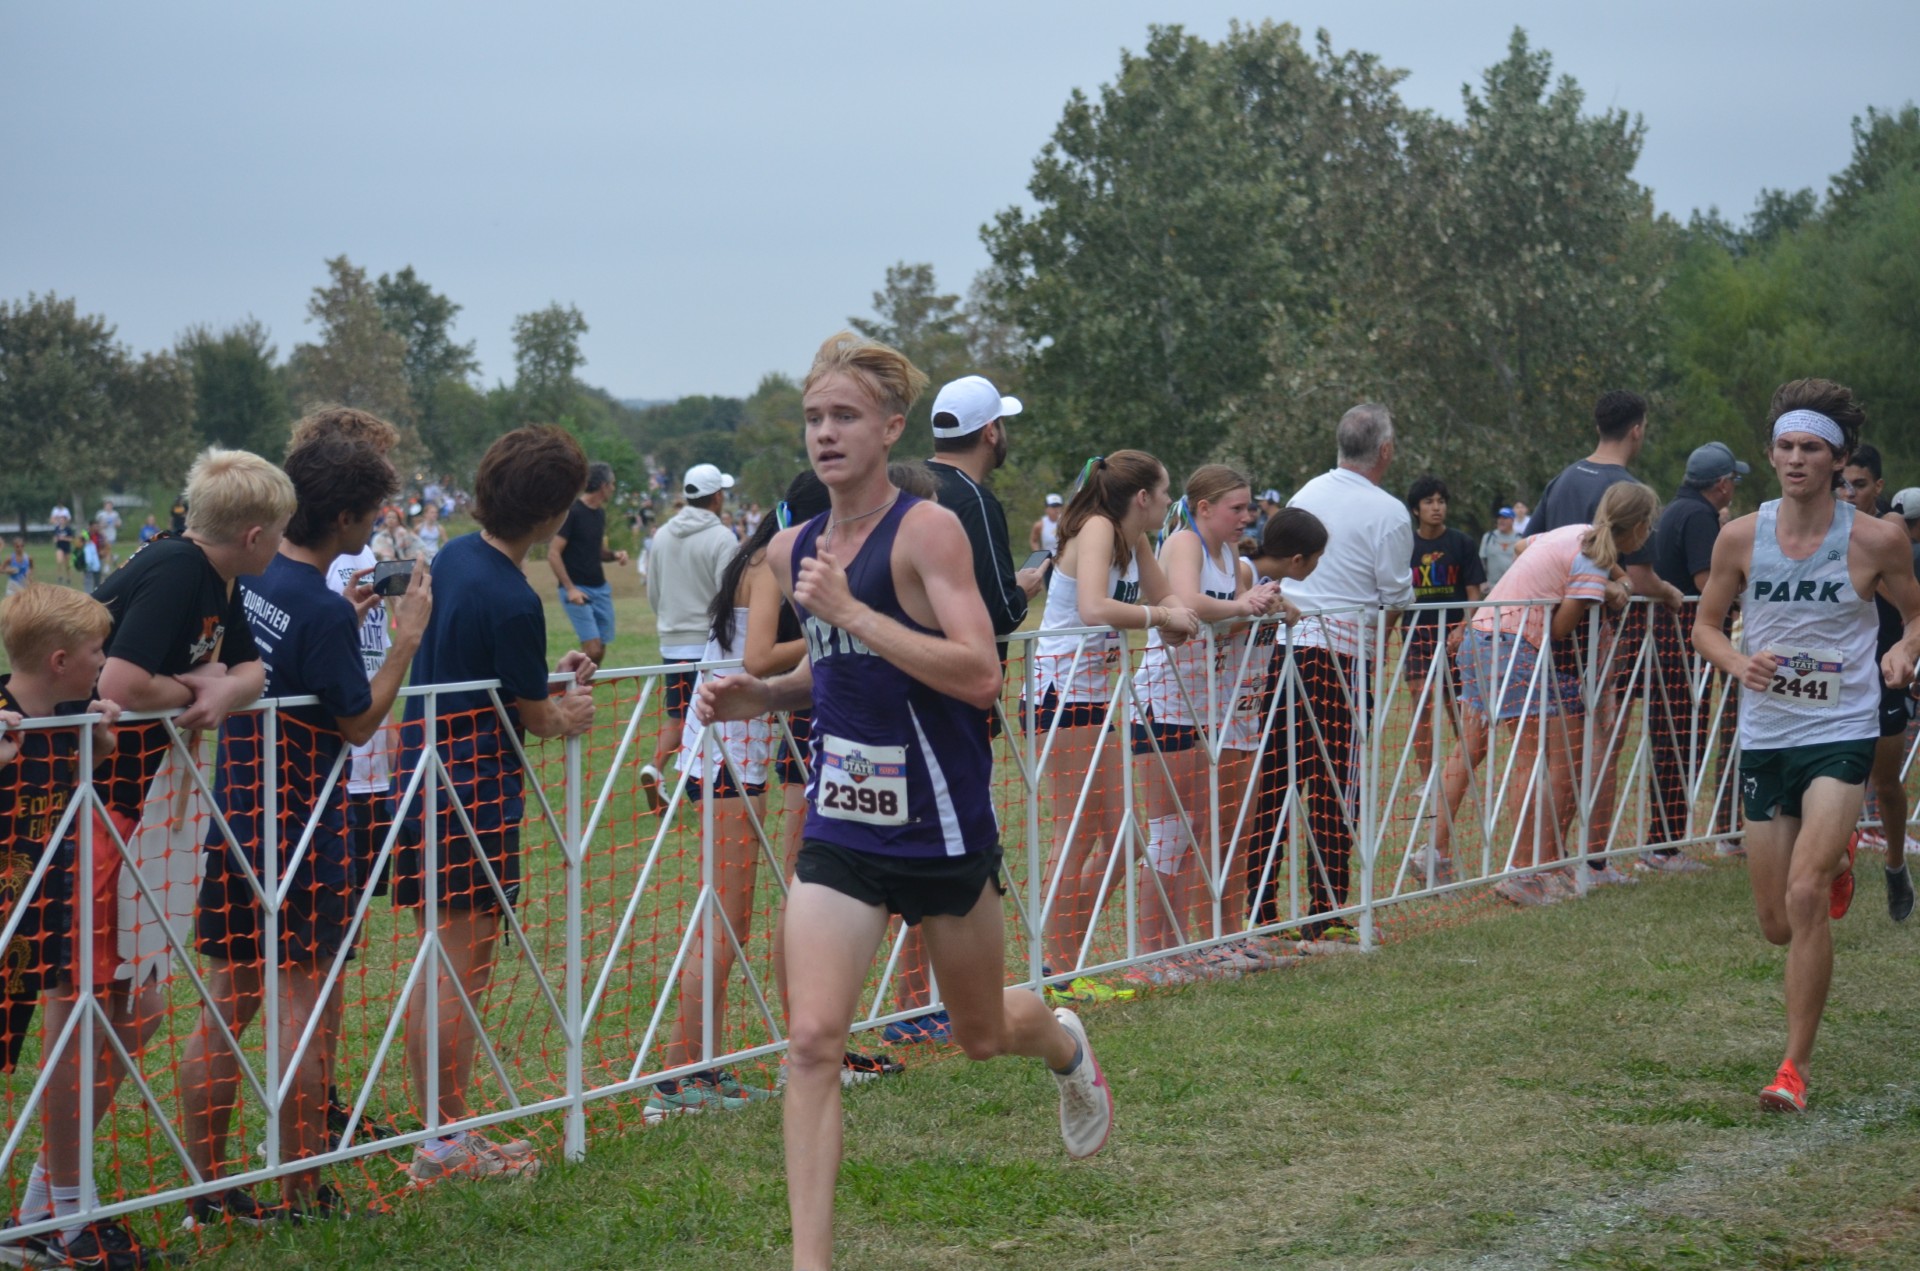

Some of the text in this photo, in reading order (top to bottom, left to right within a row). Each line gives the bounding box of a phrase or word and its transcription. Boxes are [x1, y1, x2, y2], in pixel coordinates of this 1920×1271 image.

[1754, 580, 1845, 604] PARK
[243, 589, 291, 633] QUALIFIER
[1790, 660, 1818, 671] STATE
[1772, 675, 1828, 701] 2441
[843, 761, 874, 775] STATE
[823, 781, 898, 817] 2398
